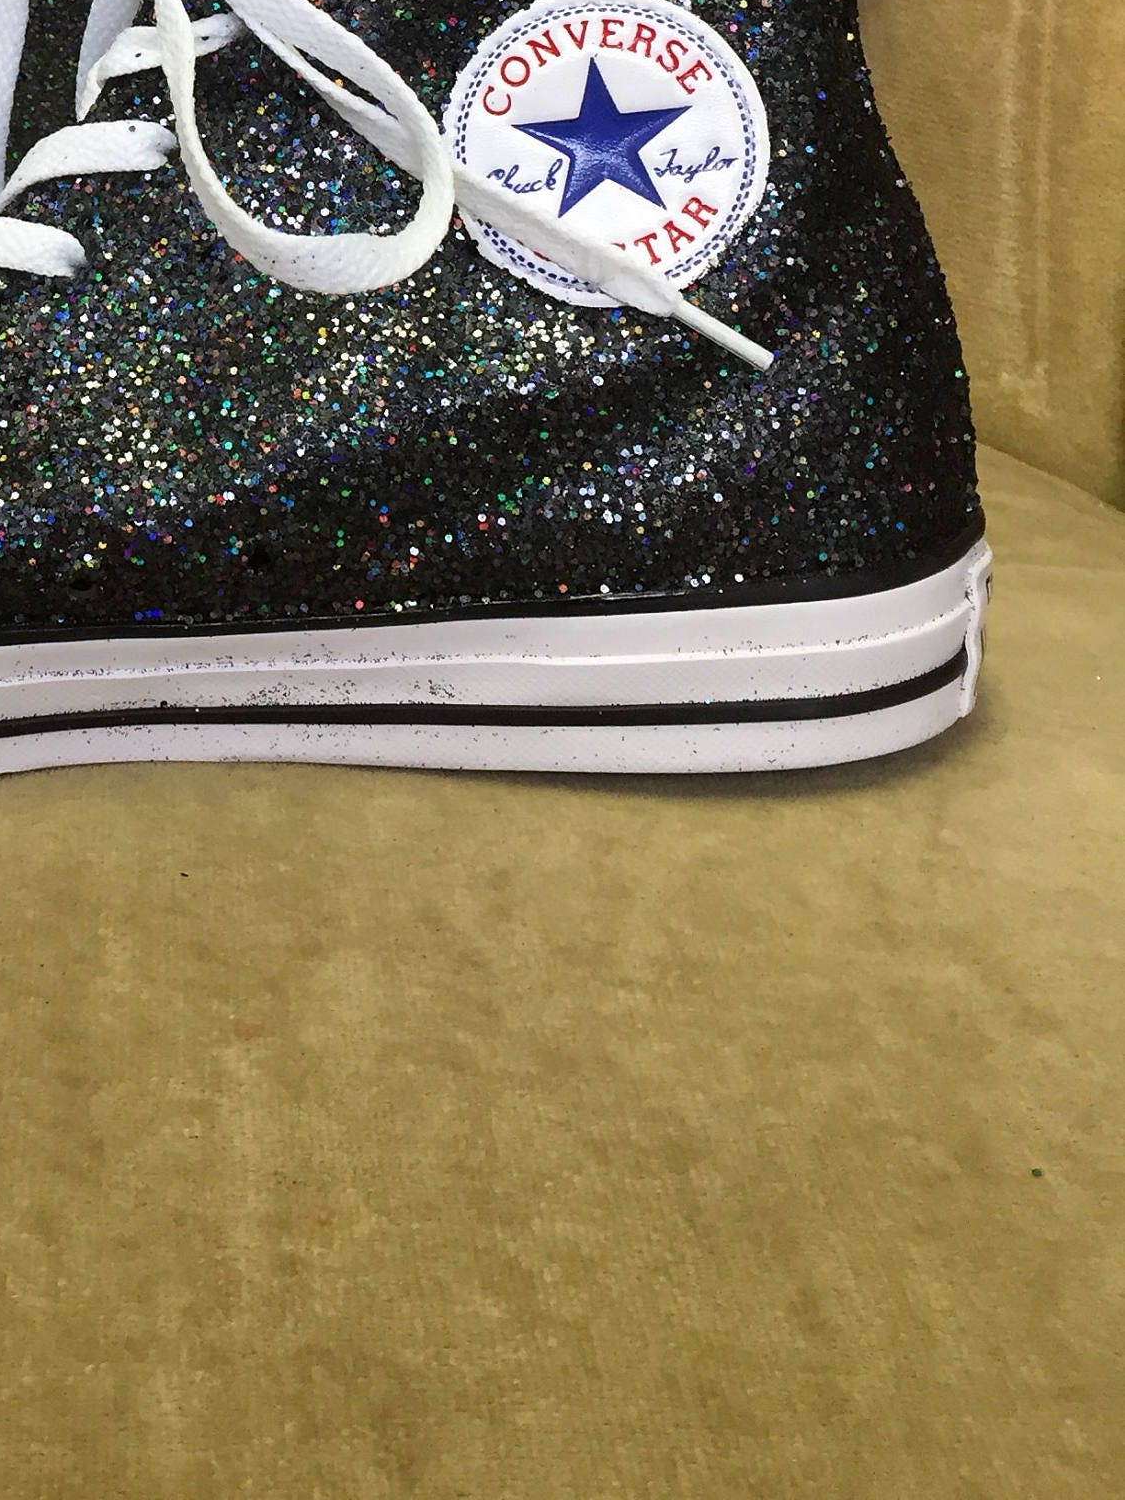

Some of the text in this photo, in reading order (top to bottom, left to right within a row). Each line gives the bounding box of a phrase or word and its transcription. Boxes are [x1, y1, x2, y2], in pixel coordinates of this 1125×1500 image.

[483, 19, 713, 116] CONVERSE
[486, 146, 739, 194] Chuck Taylor
[611, 196, 718, 267] TAR
